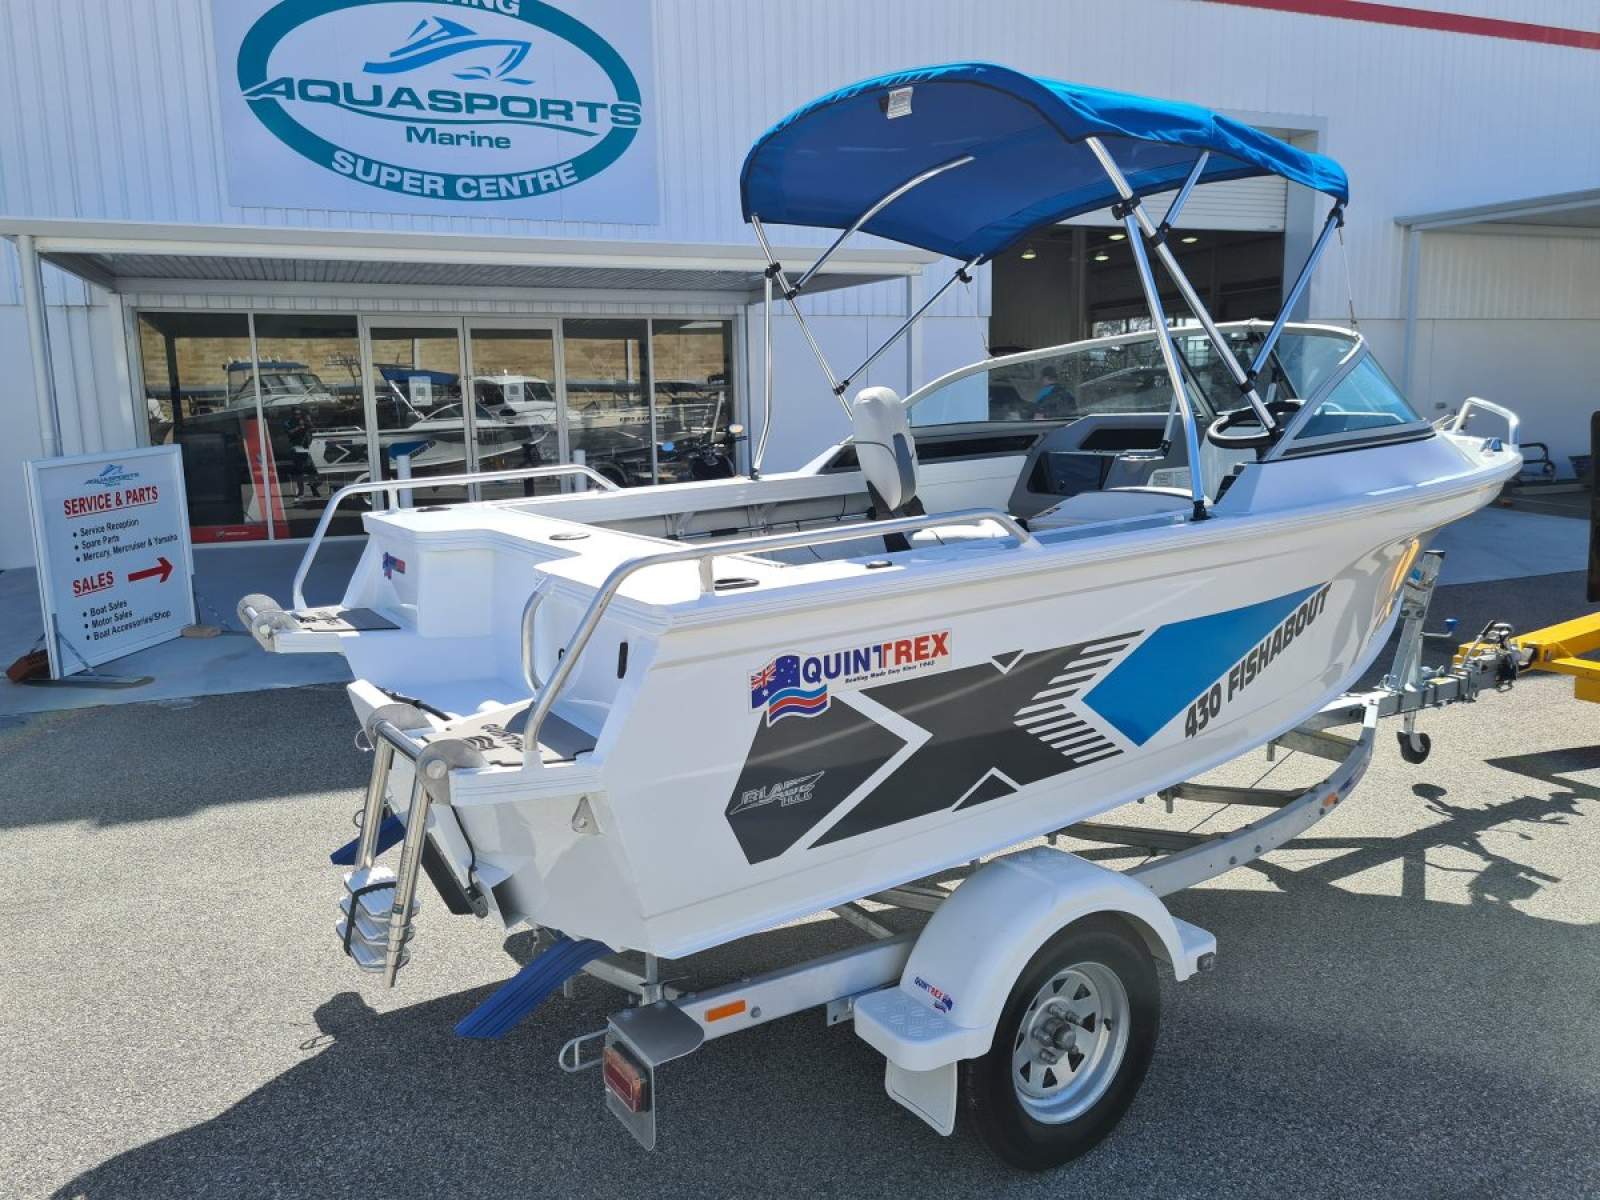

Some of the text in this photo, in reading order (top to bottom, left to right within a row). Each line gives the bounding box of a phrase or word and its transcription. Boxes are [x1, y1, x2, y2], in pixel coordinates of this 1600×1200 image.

[243, 77, 642, 127] AQUASPORTS
[406, 126, 511, 149] Marine
[331, 151, 578, 200] SUPER CENTRE
[64, 486, 158, 515] SERVICE & PARTS
[80, 519, 139, 537] Service Reception
[154, 534, 178, 545] Yamaha
[82, 535, 119, 550] Spare Parts
[72, 571, 114, 594] SALES
[90, 600, 127, 616] Boat Sales
[92, 610, 132, 628] Motor Sales
[94, 629, 110, 640] Boat
[802, 631, 949, 684] QUINTREX
[1184, 582, 1332, 739] 430 FISHABOUT
